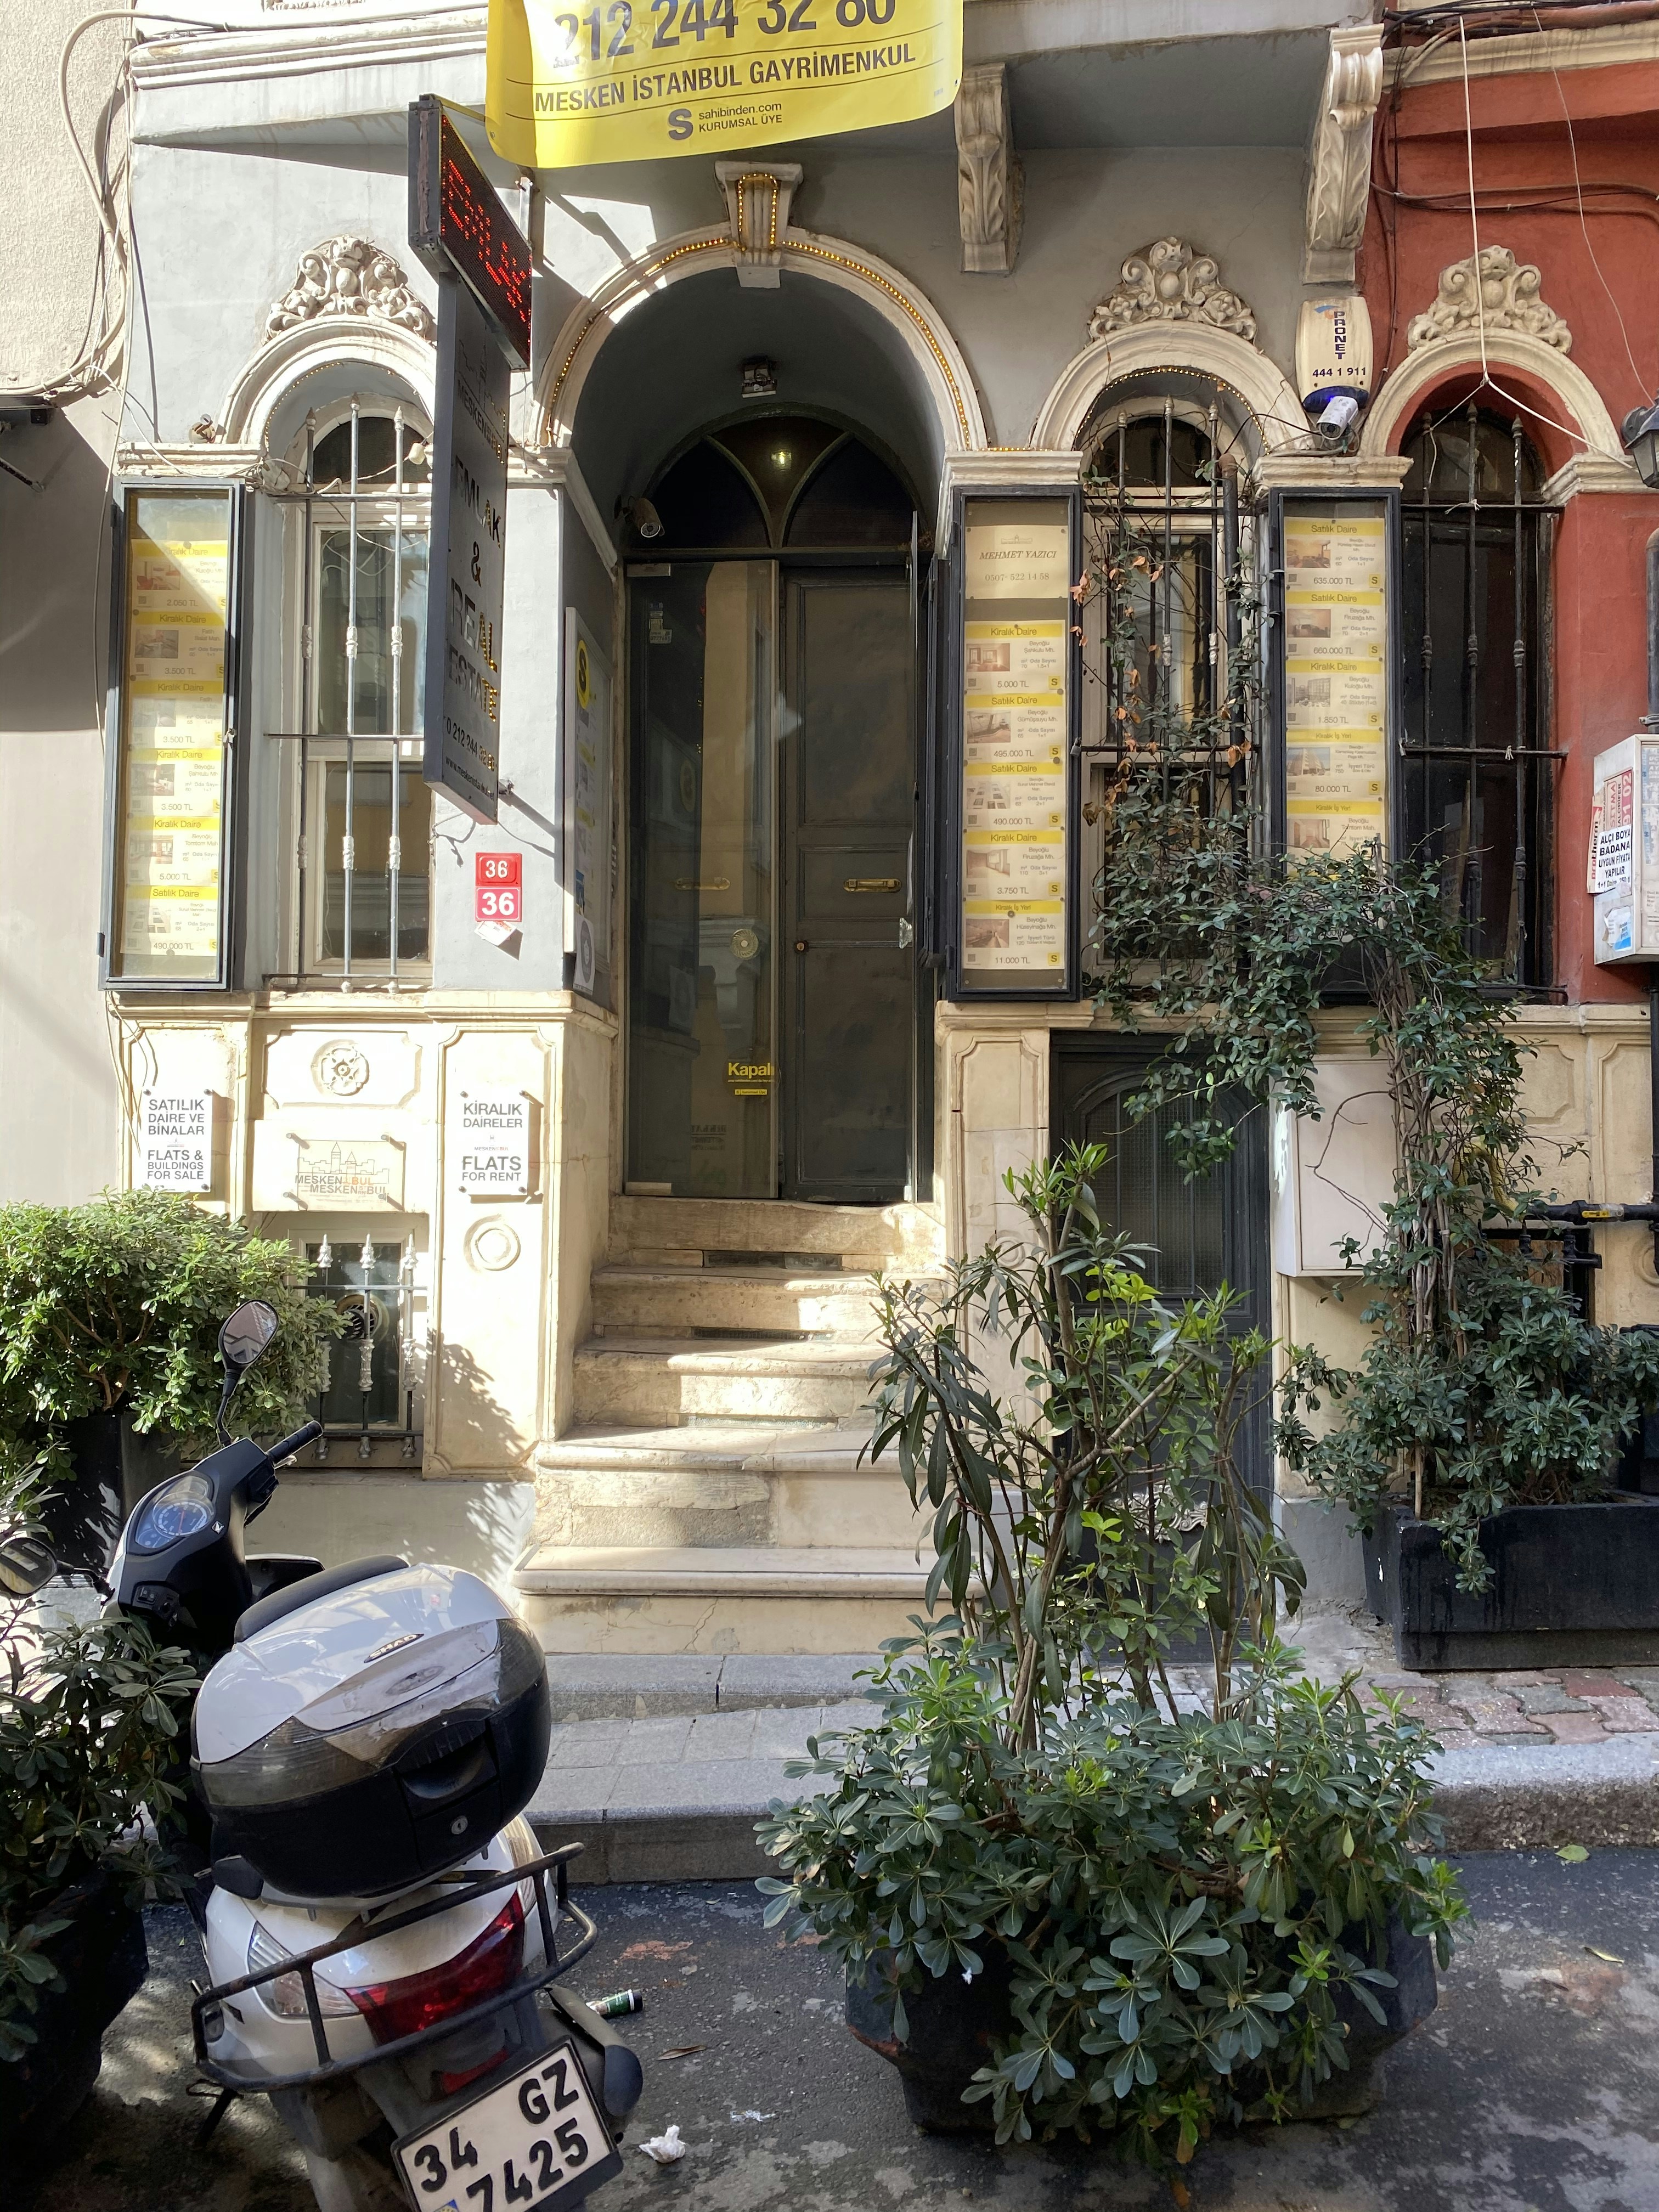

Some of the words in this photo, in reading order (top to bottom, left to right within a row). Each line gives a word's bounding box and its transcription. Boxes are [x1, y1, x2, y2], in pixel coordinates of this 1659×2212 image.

[554, 1, 634, 68] 212
[651, 0, 738, 49] 244
[758, 0, 816, 34] 32
[535, 82, 624, 112] MESKEN
[633, 65, 742, 101] İSTANBUL
[750, 43, 916, 84] GAYRİMENKUL
[699, 102, 782, 120] sahibinden.com
[699, 117, 758, 133] KURUMSAL
[761, 113, 782, 126] ÜYE
[1334, 311, 1346, 360] PRONET
[1312, 368, 1333, 377] 444
[1337, 368, 1342, 376] 1
[1347, 367, 1365, 375] 911
[455, 454, 501, 550] EMLAK
[1337, 525, 1357, 533] Daire
[979, 551, 1024, 560] MEHMET
[471, 541, 481, 588] &
[1337, 594, 1357, 602] Daire
[160, 614, 183, 623] Kiralık
[185, 614, 206, 623] Daire
[451, 577, 498, 674] REAL
[991, 628, 1014, 636] Kiralık
[1336, 663, 1357, 671] Daire
[449, 644, 498, 723] ESTATE
[991, 697, 1014, 705] Satılık
[182, 751, 202, 759] Daire
[991, 765, 1014, 773] Satılık
[154, 820, 178, 828] Kiralık
[180, 820, 201, 828] Daire
[1600, 833, 1614, 845] ALÇI
[1616, 828, 1630, 840] BOYA
[1599, 840, 1630, 856] BADANA
[1599, 856, 1615, 867] UYGUN
[486, 860, 507, 878] 36
[1605, 866, 1625, 878] YAPILIR
[153, 889, 176, 897] Satılık
[178, 889, 199, 898] Daire
[482, 892, 515, 916] 36
[153, 942, 183, 950] 490.000
[149, 1099, 205, 1110] SATILIK
[464, 1101, 522, 1115] KİRALIK
[148, 1111, 185, 1123] DAİRE
[189, 1113, 205, 1123] VE
[463, 1116, 523, 1128] DAİRELER
[148, 1122, 205, 1135] BİNALAR
[148, 1150, 190, 1160] FLATS
[194, 1150, 204, 1160] &
[462, 1156, 522, 1171] FLATS
[147, 1171, 171, 1180] FOR
[174, 1171, 204, 1180] SALE
[295, 1175, 342, 1184] MESKEN
[462, 1172, 486, 1181] FOR
[490, 1172, 522, 1181] RENT
[518, 2058, 579, 2125] GZ
[414, 2126, 478, 2192] 34
[466, 2117, 588, 2212] 7425
